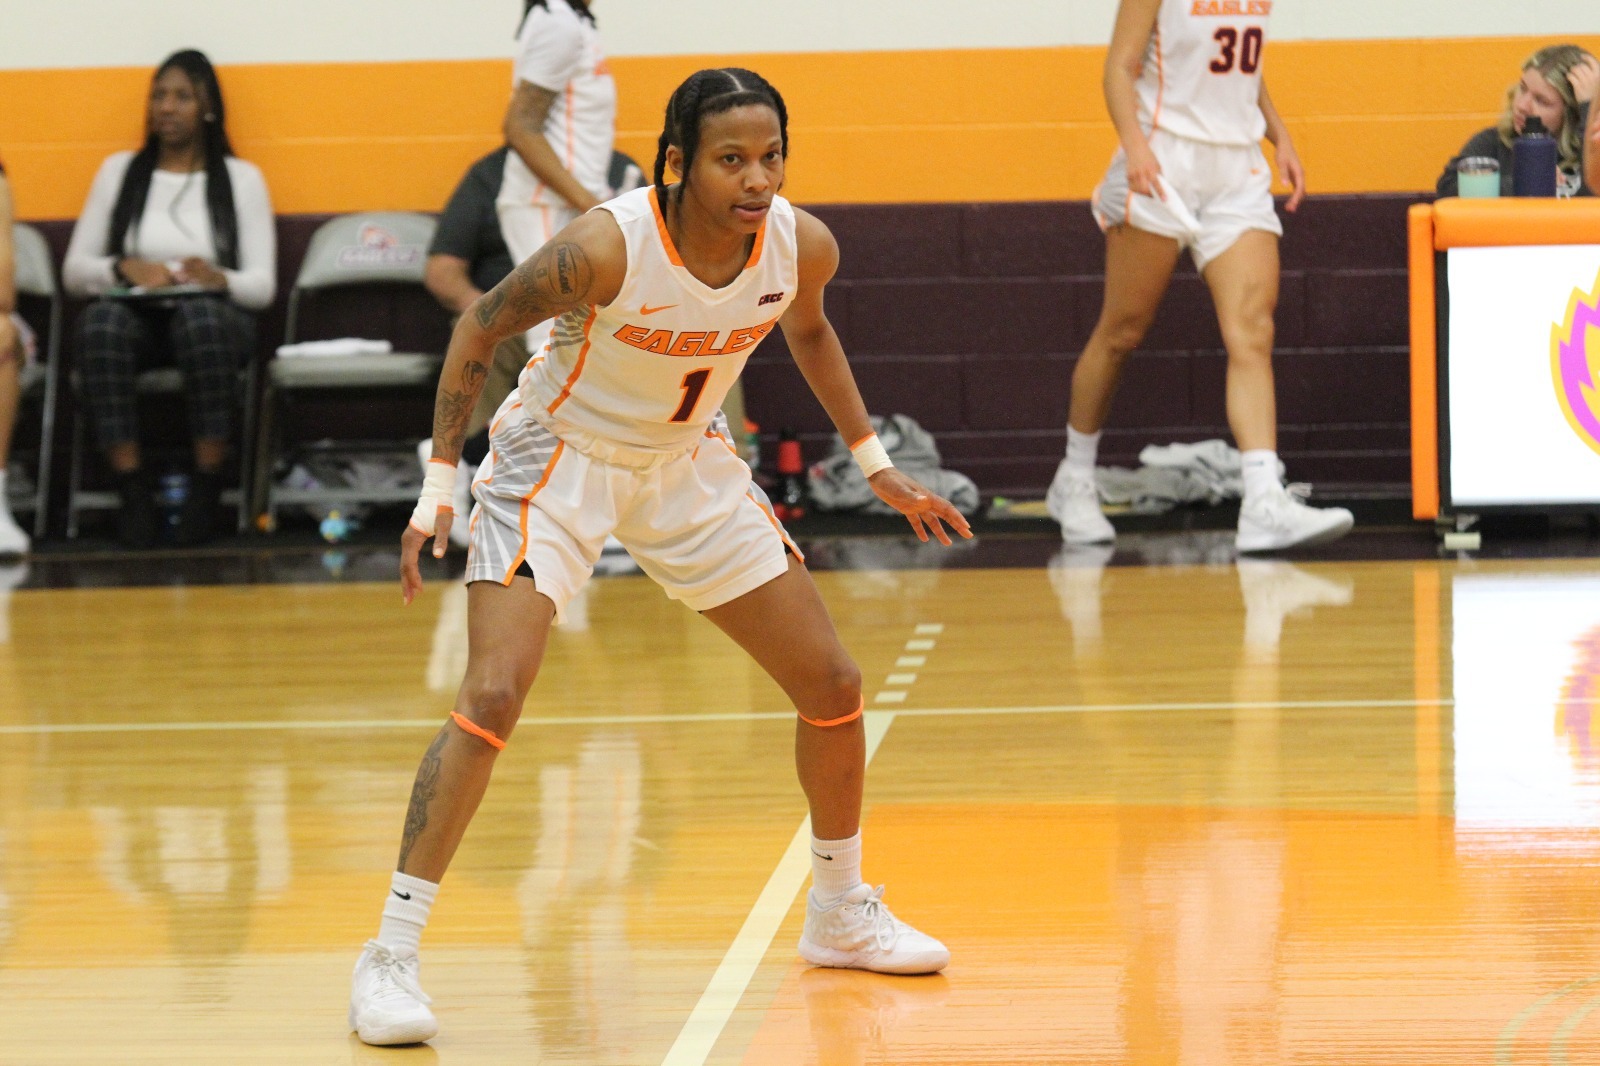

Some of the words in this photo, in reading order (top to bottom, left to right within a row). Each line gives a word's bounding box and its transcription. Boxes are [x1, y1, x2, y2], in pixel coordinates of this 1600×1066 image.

[1208, 26, 1263, 75] 30
[613, 315, 780, 357] EAGLES
[667, 366, 714, 423] 1
